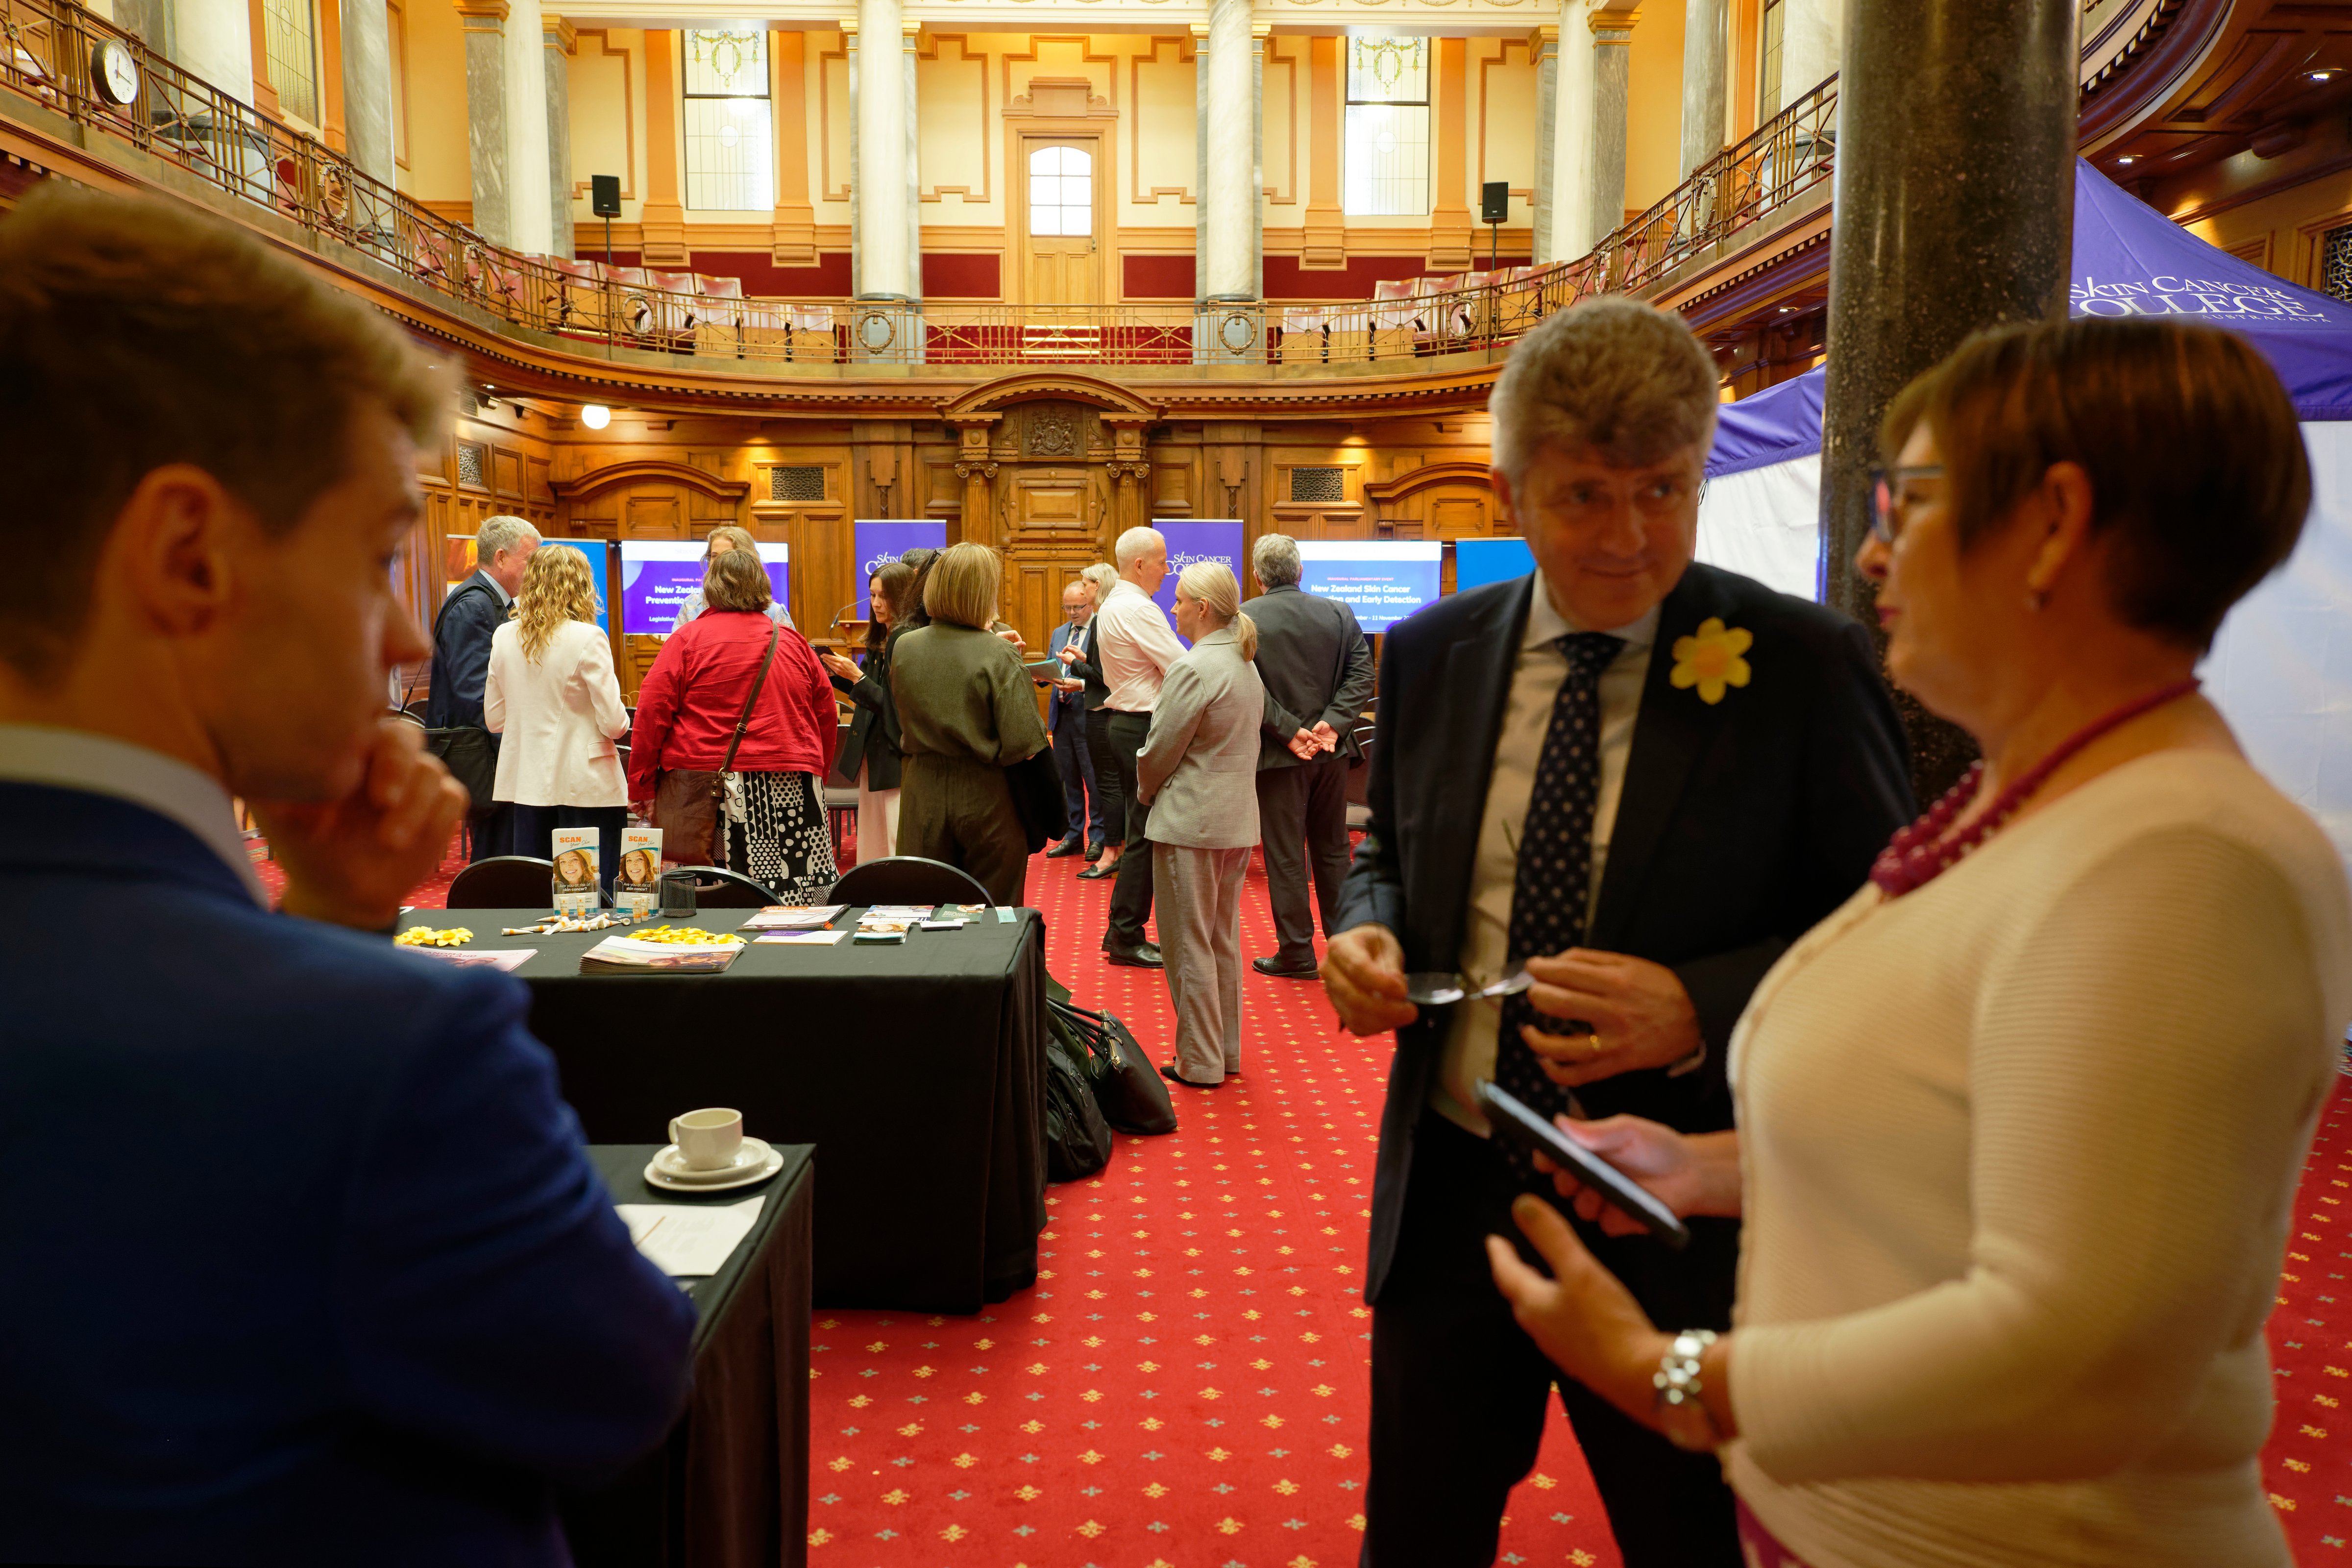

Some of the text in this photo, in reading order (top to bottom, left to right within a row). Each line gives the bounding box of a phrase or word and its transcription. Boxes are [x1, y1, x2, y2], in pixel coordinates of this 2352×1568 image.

[2152, 276, 2294, 300] CANCER
[1196, 554, 1232, 564] CANCER
[1362, 595, 1382, 605] Early
